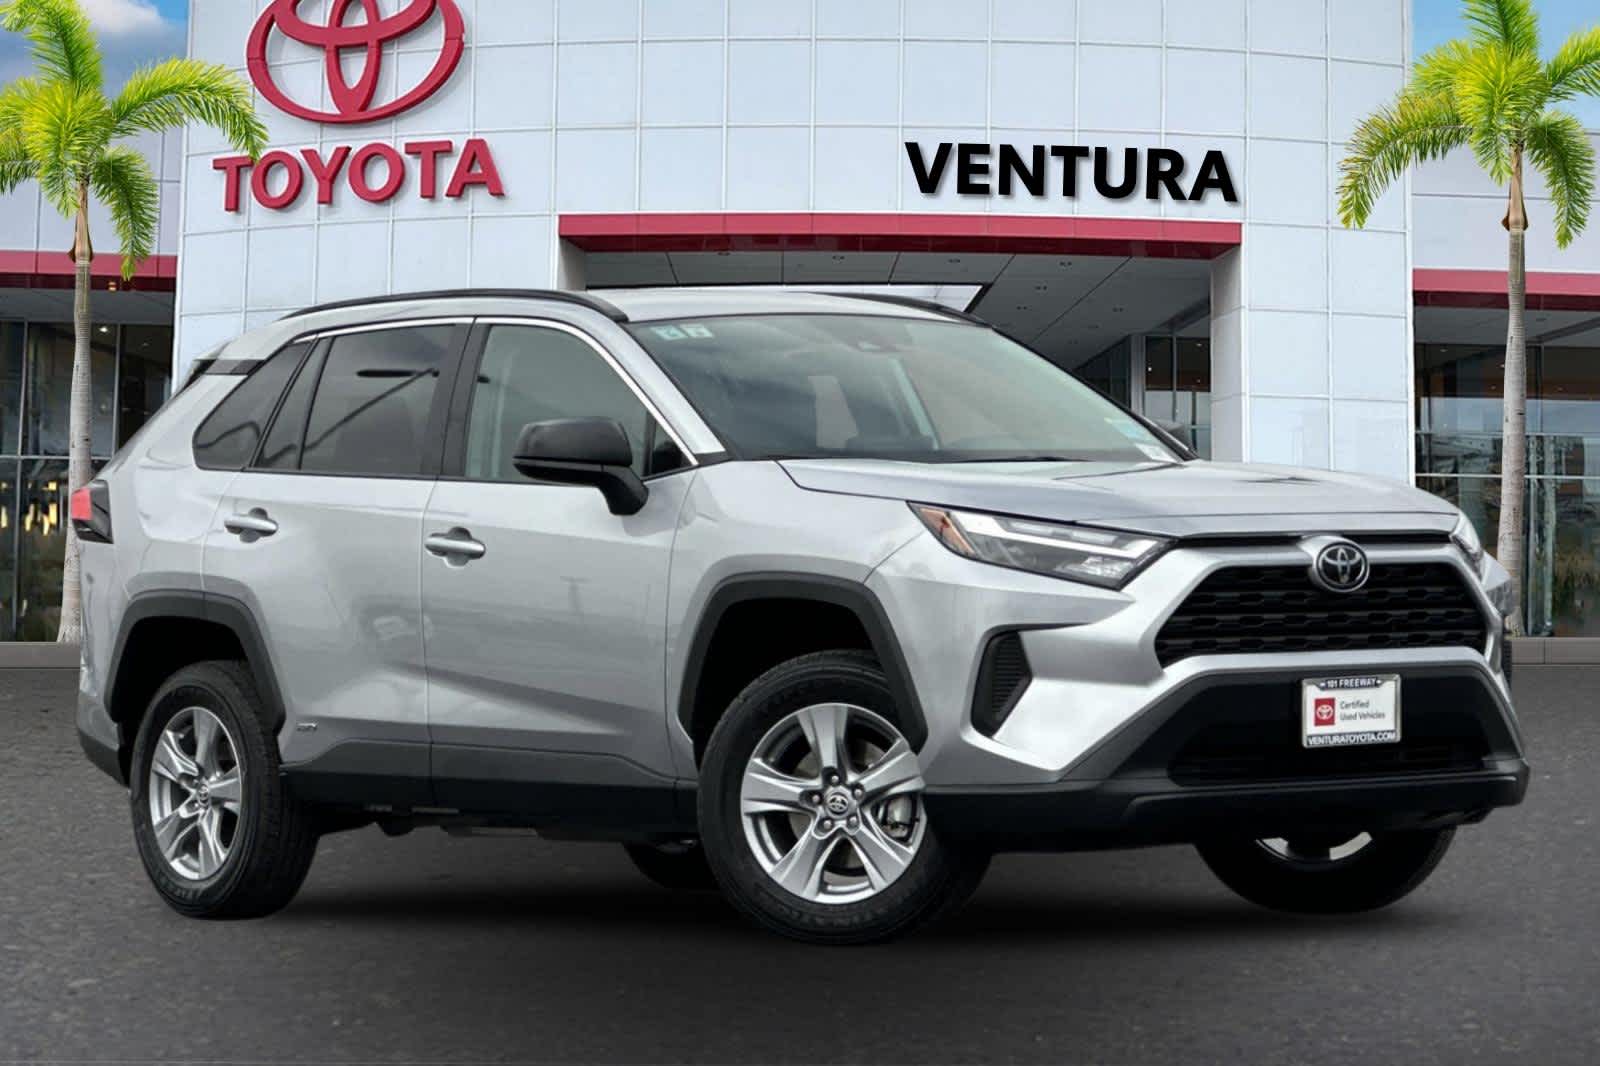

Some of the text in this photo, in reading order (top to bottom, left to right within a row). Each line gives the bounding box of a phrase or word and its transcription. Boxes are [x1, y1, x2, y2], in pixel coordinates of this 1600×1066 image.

[213, 139, 505, 212] TOYOTA
[905, 142, 1238, 202] VENTURA
[1340, 678, 1376, 688] FREEWAY
[1340, 700, 1370, 709] Certified
[1340, 711, 1386, 720] Used Vehicles
[1308, 732, 1395, 746] VENTURATOYOTA.COM
